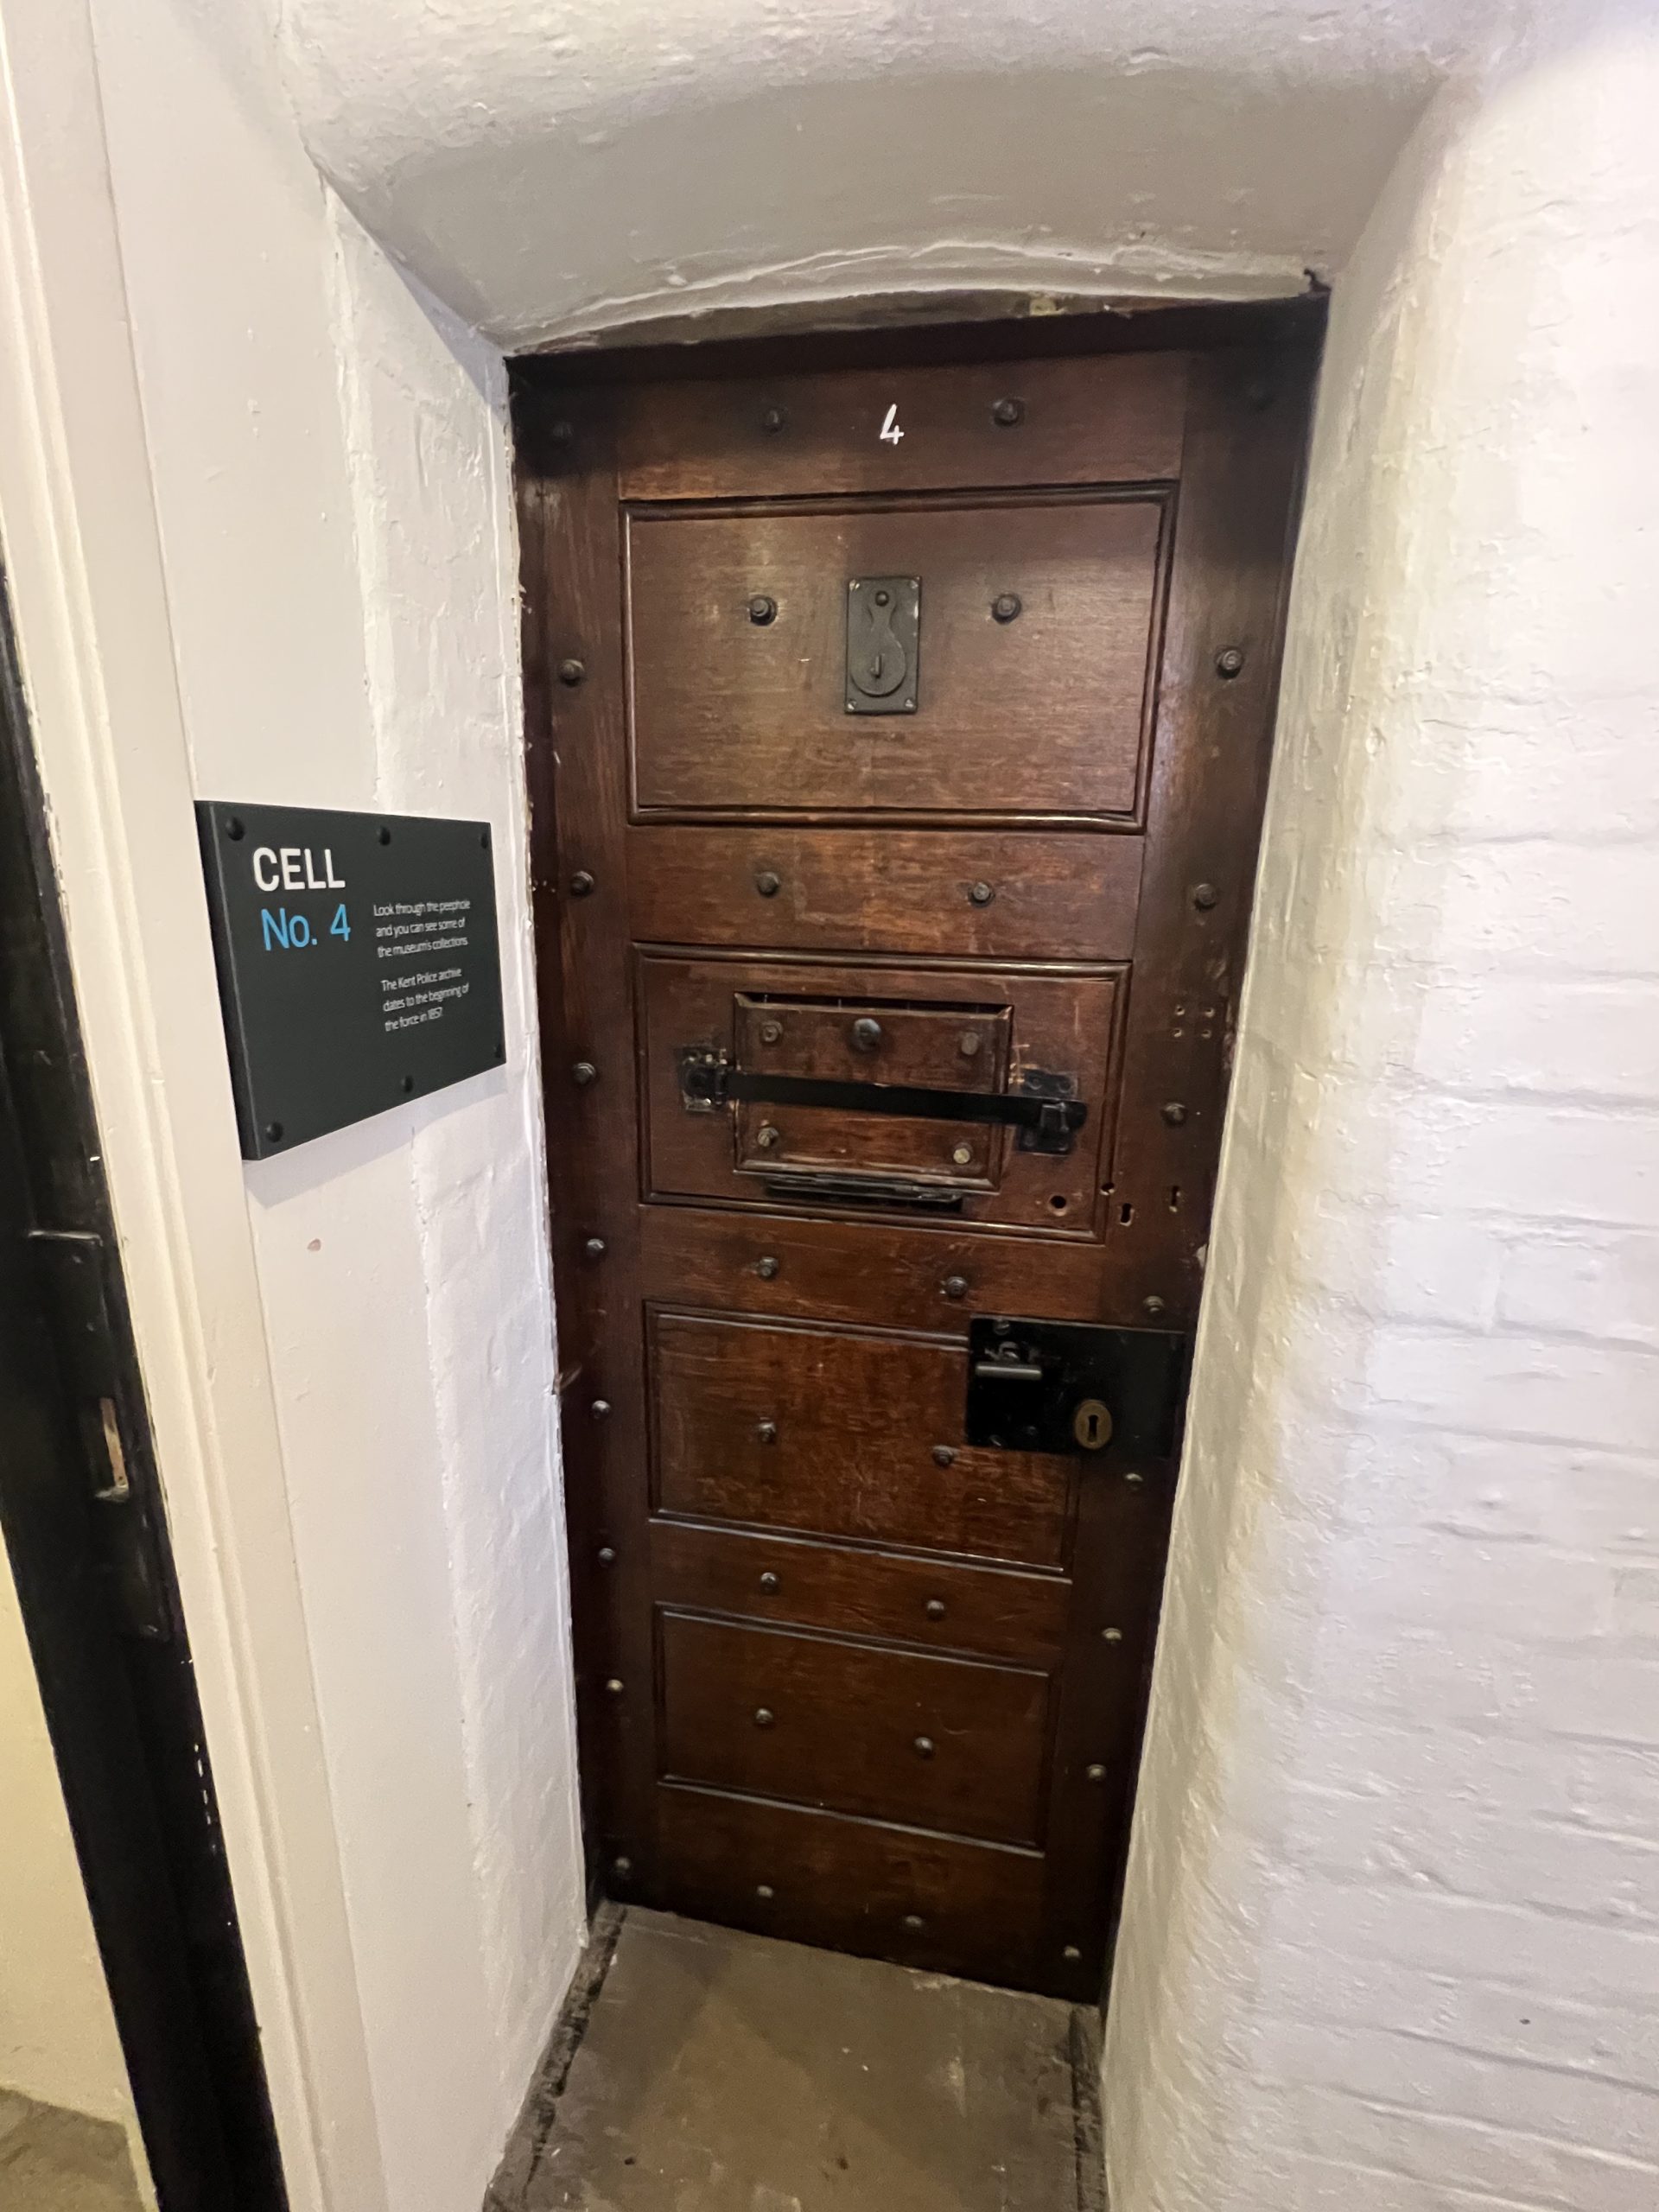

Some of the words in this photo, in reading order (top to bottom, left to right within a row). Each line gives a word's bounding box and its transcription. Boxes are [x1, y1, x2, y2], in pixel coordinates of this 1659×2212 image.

[880, 404, 904, 445] 4
[253, 847, 346, 892] CELL
[373, 904, 394, 916] Look
[395, 903, 425, 916] through
[426, 901, 438, 912] the
[261, 907, 317, 951] No.
[330, 903, 351, 942] 4
[376, 925, 392, 937] and
[393, 925, 410, 938] you
[410, 924, 424, 933] can
[424, 922, 437, 931] see
[438, 919, 457, 931] some
[458, 917, 466, 928] of
[378, 945, 392, 957] the
[380, 979, 397, 991] The
[397, 976, 416, 988] Kent
[416, 972, 438, 984] Police
[383, 999, 405, 1012] dates
[406, 996, 415, 1007] to
[415, 993, 429, 1004] the
[429, 987, 462, 1002] beginning
[461, 982, 469, 994] of
[385, 1020, 399, 1032] the
[399, 1016, 419, 1027] force
[419, 1013, 428, 1022] in
